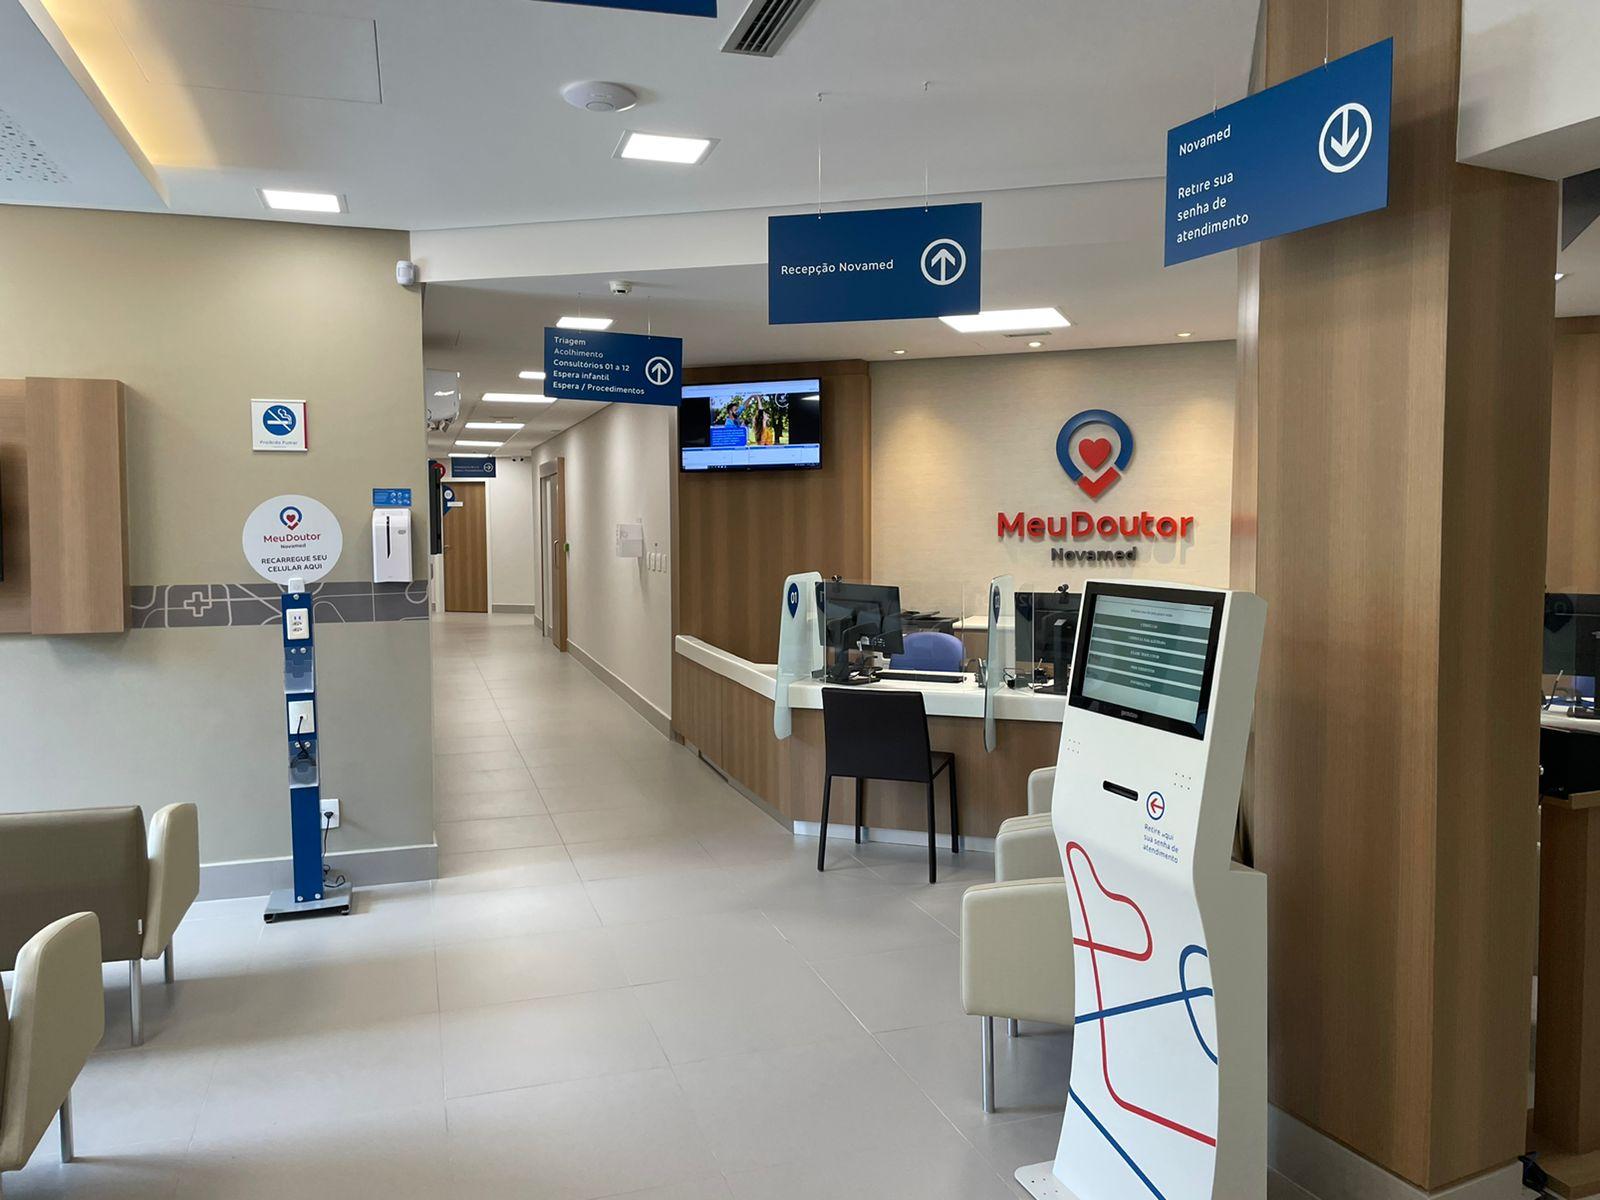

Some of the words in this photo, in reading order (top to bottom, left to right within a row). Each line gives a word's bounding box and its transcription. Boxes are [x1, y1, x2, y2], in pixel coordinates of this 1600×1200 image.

[1179, 124, 1231, 156] Novamed
[1178, 179, 1210, 199] Retire
[1213, 172, 1234, 189] sua
[1177, 202, 1209, 221] senha
[1212, 196, 1227, 211] de
[1176, 213, 1249, 243] atendimento
[781, 262, 836, 275] Recepção
[839, 260, 894, 272] Novamed
[554, 336, 586, 346] Triagem
[554, 348, 604, 358] Acolhimento
[553, 359, 604, 370] Consultórios
[553, 370, 580, 379] Espera
[581, 371, 610, 381] infantil
[553, 382, 580, 391] Espera
[581, 383, 586, 391] /
[587, 384, 645, 395] Procedimentos
[997, 511, 1194, 538] MeuDoutor
[263, 533, 321, 543] MeuDoutor
[261, 555, 311, 564] RECARREGUE
[1051, 546, 1137, 562] Novamed
[267, 564, 302, 572] CELULAR
[303, 563, 323, 571] AQUI
